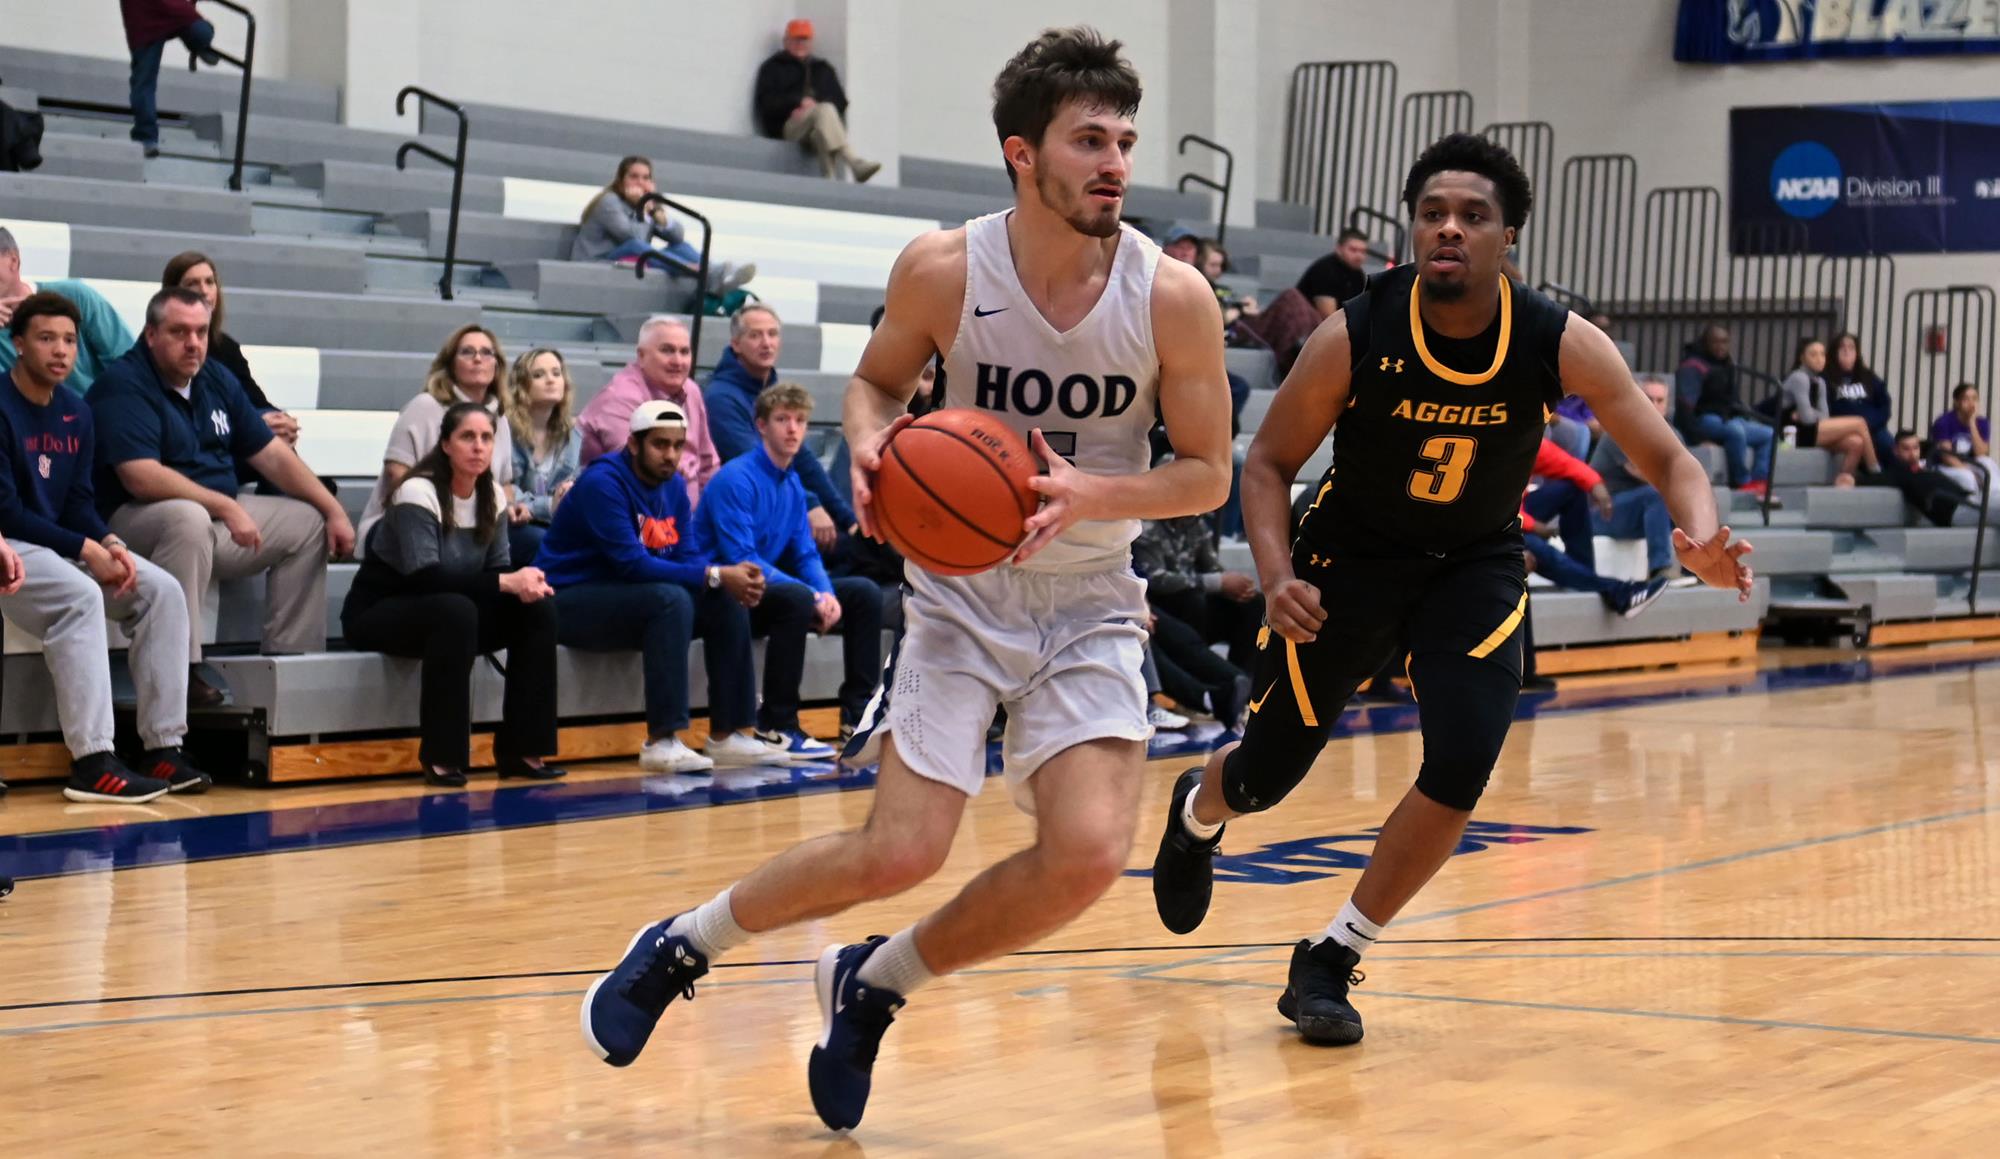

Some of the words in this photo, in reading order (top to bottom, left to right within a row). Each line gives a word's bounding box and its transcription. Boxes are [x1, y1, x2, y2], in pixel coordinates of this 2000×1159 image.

[1776, 178, 1840, 200] NCAA
[1847, 176, 1921, 198] Division
[1927, 176, 1941, 195] III
[974, 362, 1137, 419] HOOD
[1391, 399, 1509, 426] AGGIES
[1406, 434, 1479, 505] 3
